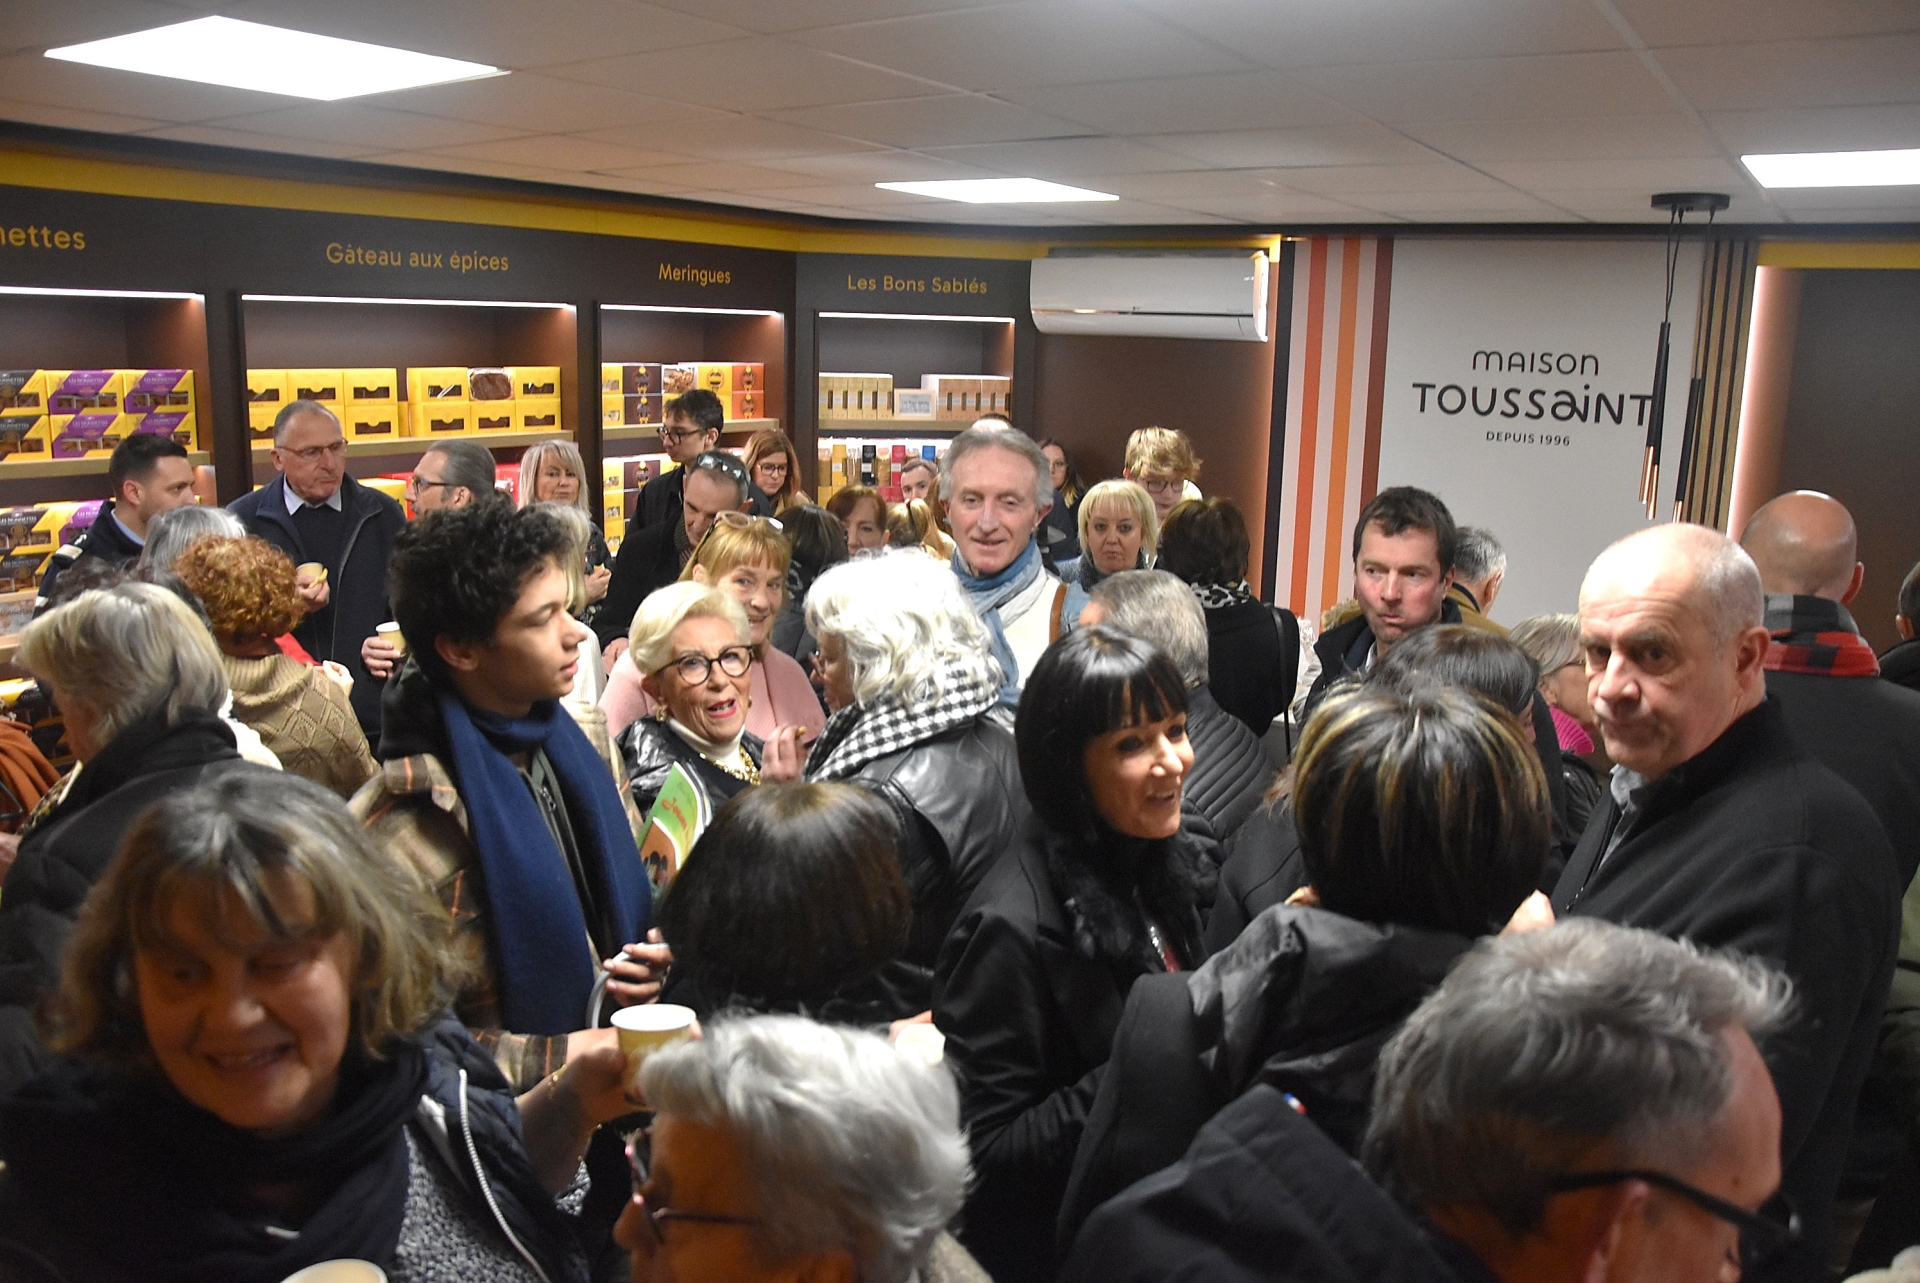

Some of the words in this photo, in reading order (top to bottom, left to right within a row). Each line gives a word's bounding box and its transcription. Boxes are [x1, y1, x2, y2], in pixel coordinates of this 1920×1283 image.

[326, 242, 402, 266] Gâteau
[409, 252, 442, 268] aux
[450, 250, 509, 273] épices
[658, 263, 732, 287] Meringues
[847, 274, 876, 291] Les
[883, 275, 925, 291] Bons
[932, 277, 987, 294] Sablés
[1486, 431, 1535, 444] DEPUIS
[1540, 434, 1570, 446] 1996
